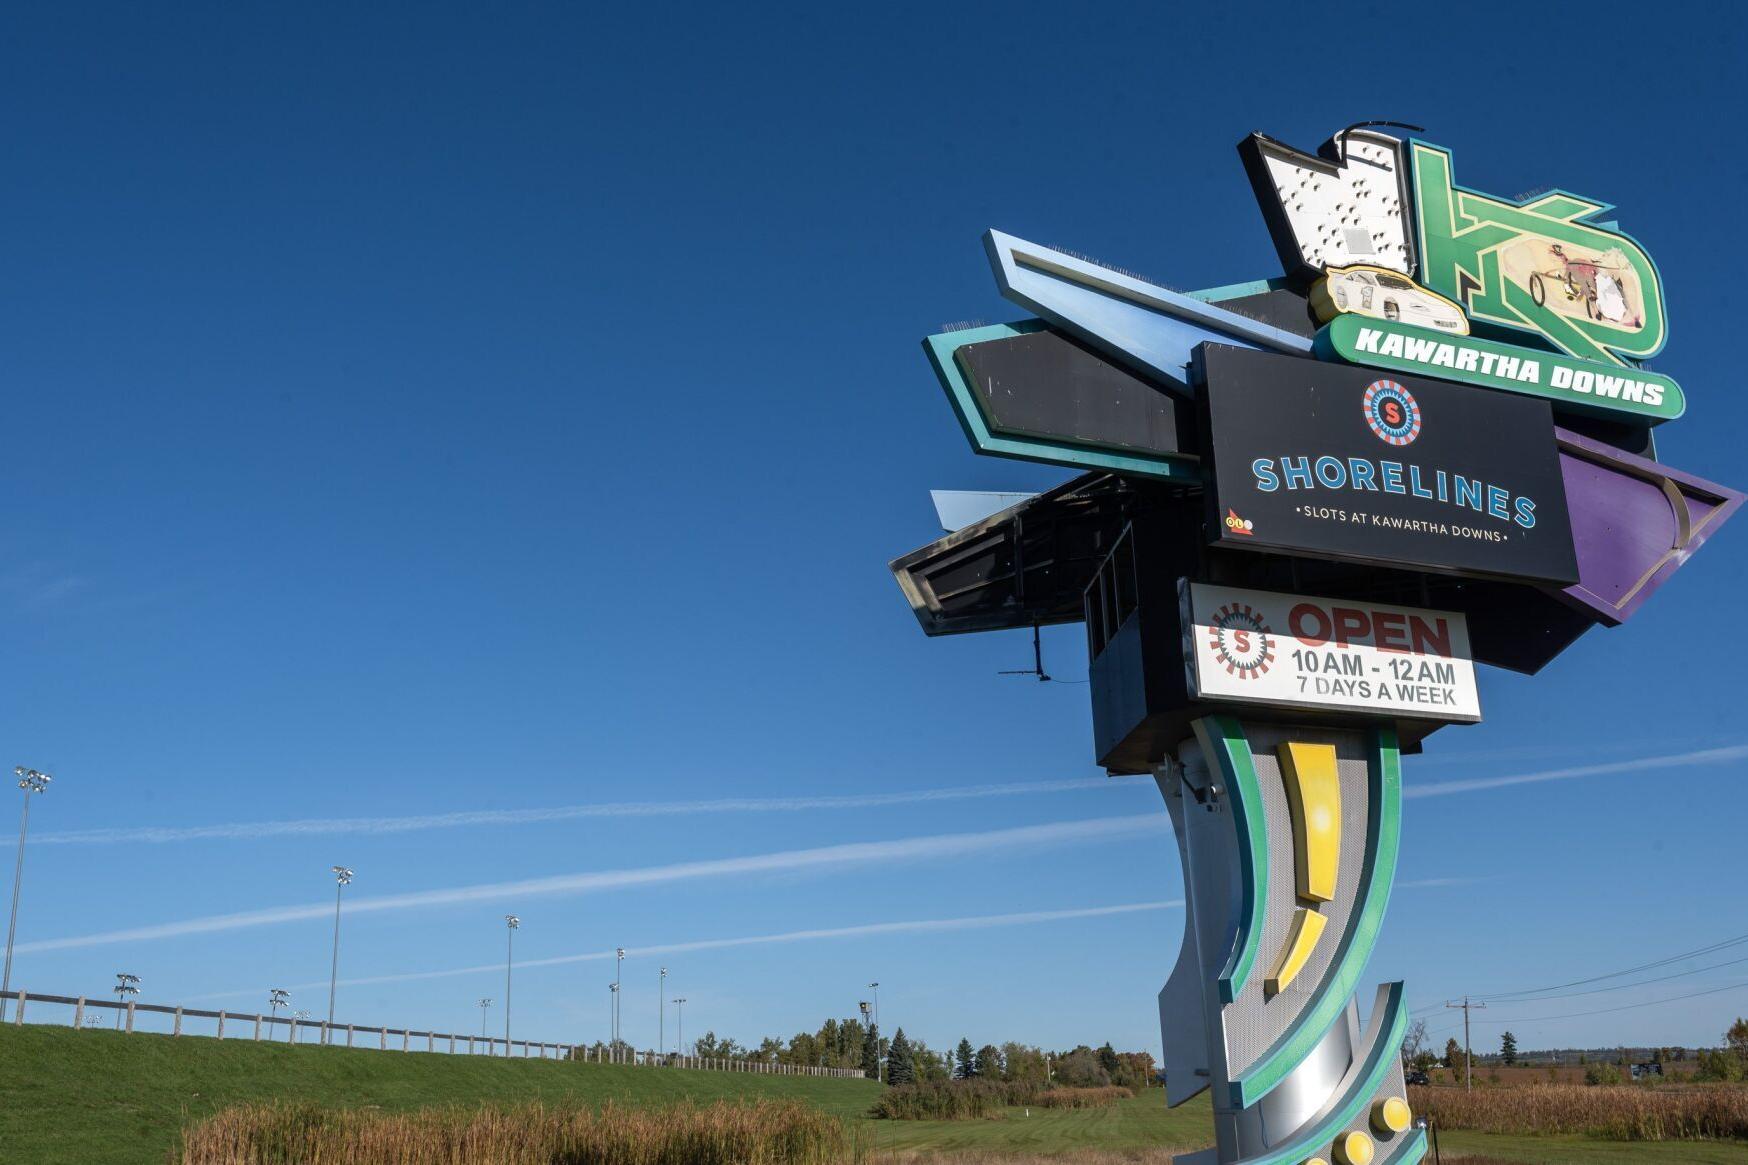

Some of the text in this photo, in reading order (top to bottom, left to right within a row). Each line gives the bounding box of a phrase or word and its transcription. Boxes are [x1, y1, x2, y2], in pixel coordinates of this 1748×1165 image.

[1354, 327, 1665, 407] KAWARTHA DOWNS
[1385, 402, 1401, 424] S
[1251, 455, 1537, 529] SHORELINES
[1304, 505, 1501, 542] SLOTS AT KAWARTHA DOWNS
[1233, 629, 1251, 653] S
[1288, 603, 1453, 658] OPEN
[1296, 675, 1457, 706] 7 DAYS A WEEK
